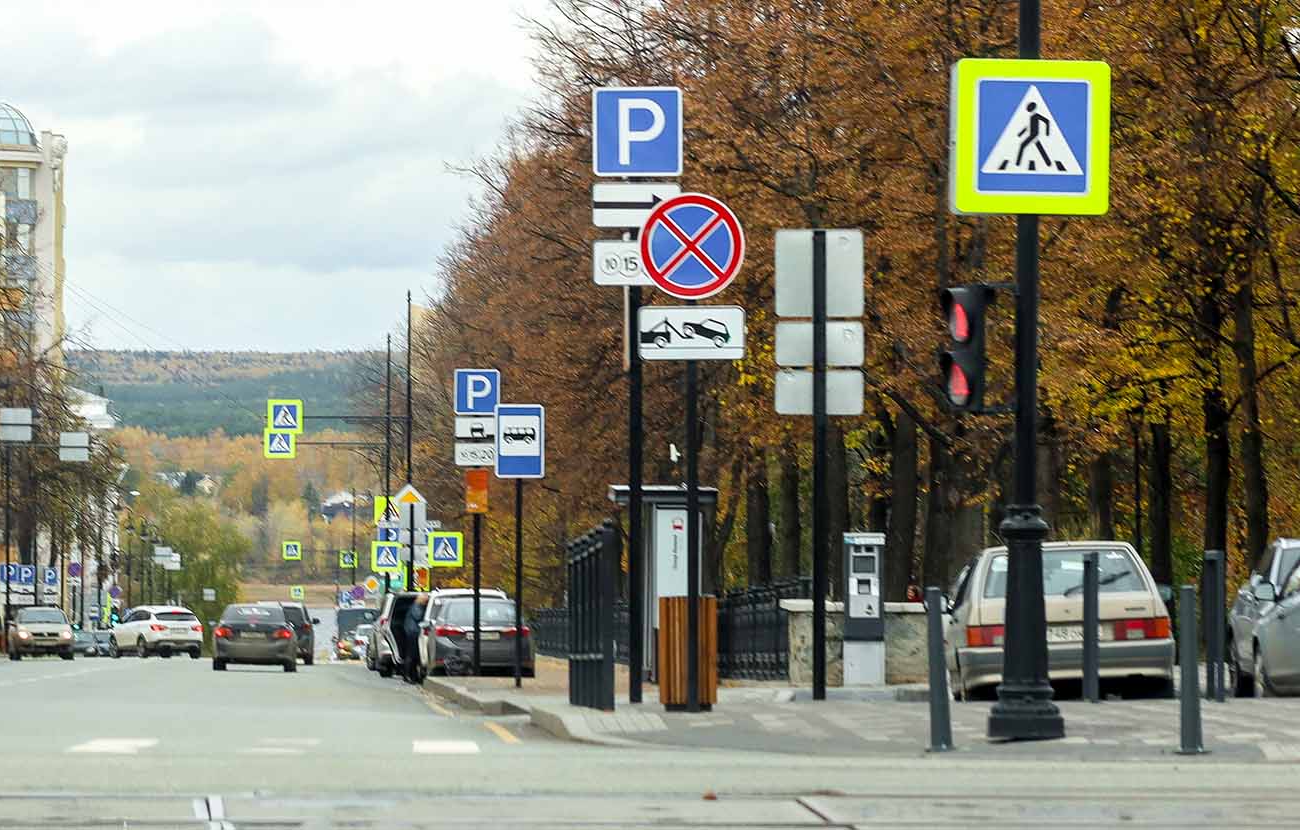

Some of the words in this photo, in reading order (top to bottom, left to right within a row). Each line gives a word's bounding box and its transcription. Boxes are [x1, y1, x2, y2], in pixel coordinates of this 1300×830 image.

[618, 98, 665, 165] P
[605, 257, 618, 270] 10
[624, 256, 638, 271] 15
[466, 374, 492, 409] P
[21, 567, 32, 582] P
[45, 569, 55, 583] P
